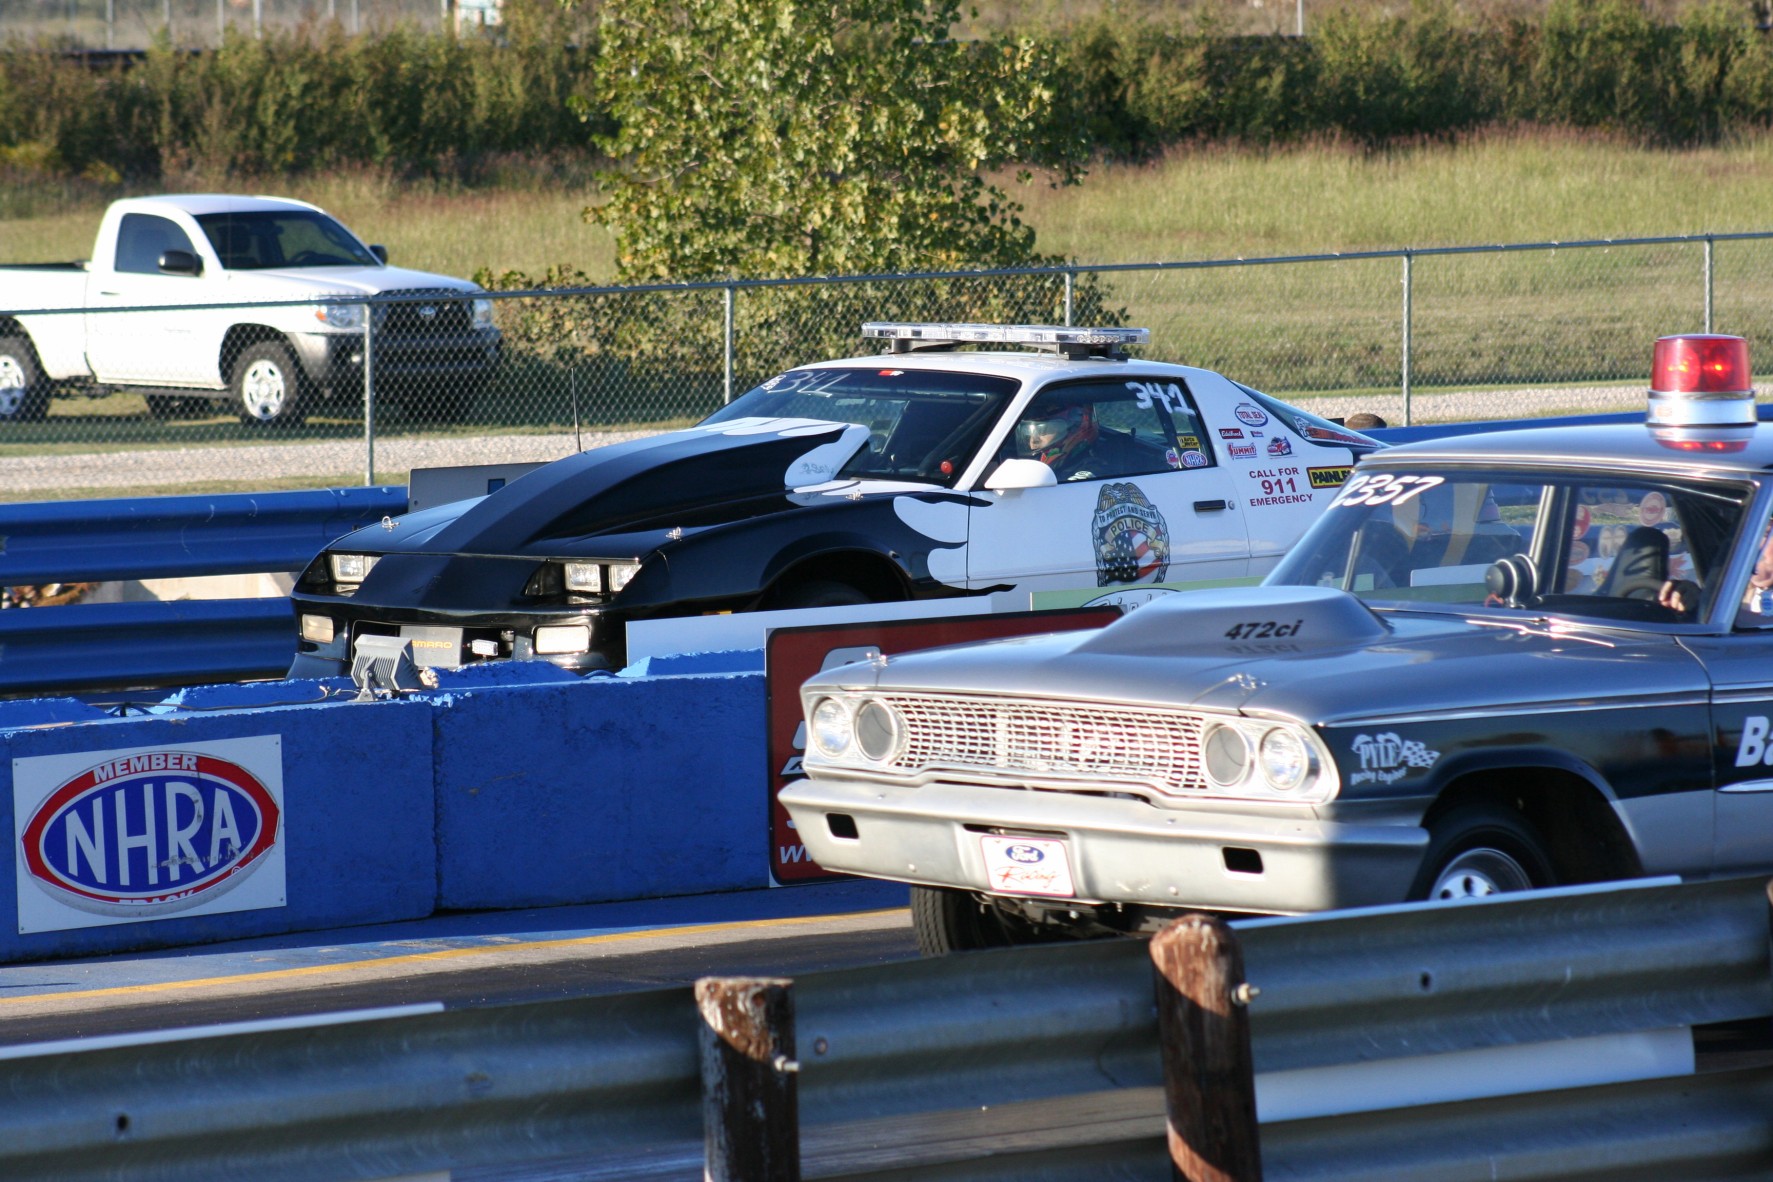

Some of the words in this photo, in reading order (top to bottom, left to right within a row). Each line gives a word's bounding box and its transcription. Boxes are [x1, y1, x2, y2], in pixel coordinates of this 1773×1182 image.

[1125, 381, 1196, 416] 341
[1249, 469, 1276, 479] CALL
[1278, 467, 1299, 476] FOR
[1311, 470, 1351, 484] PAINLE
[1261, 477, 1296, 495] 911
[1249, 494, 1313, 507] EMERGENCY
[1110, 519, 1149, 536] POLICE
[1224, 619, 1304, 640] 472ci
[412, 640, 453, 649] AMARO
[93, 754, 198, 785] MEMBER
[65, 781, 242, 886] NHRA
[1011, 846, 1040, 862] Ford
